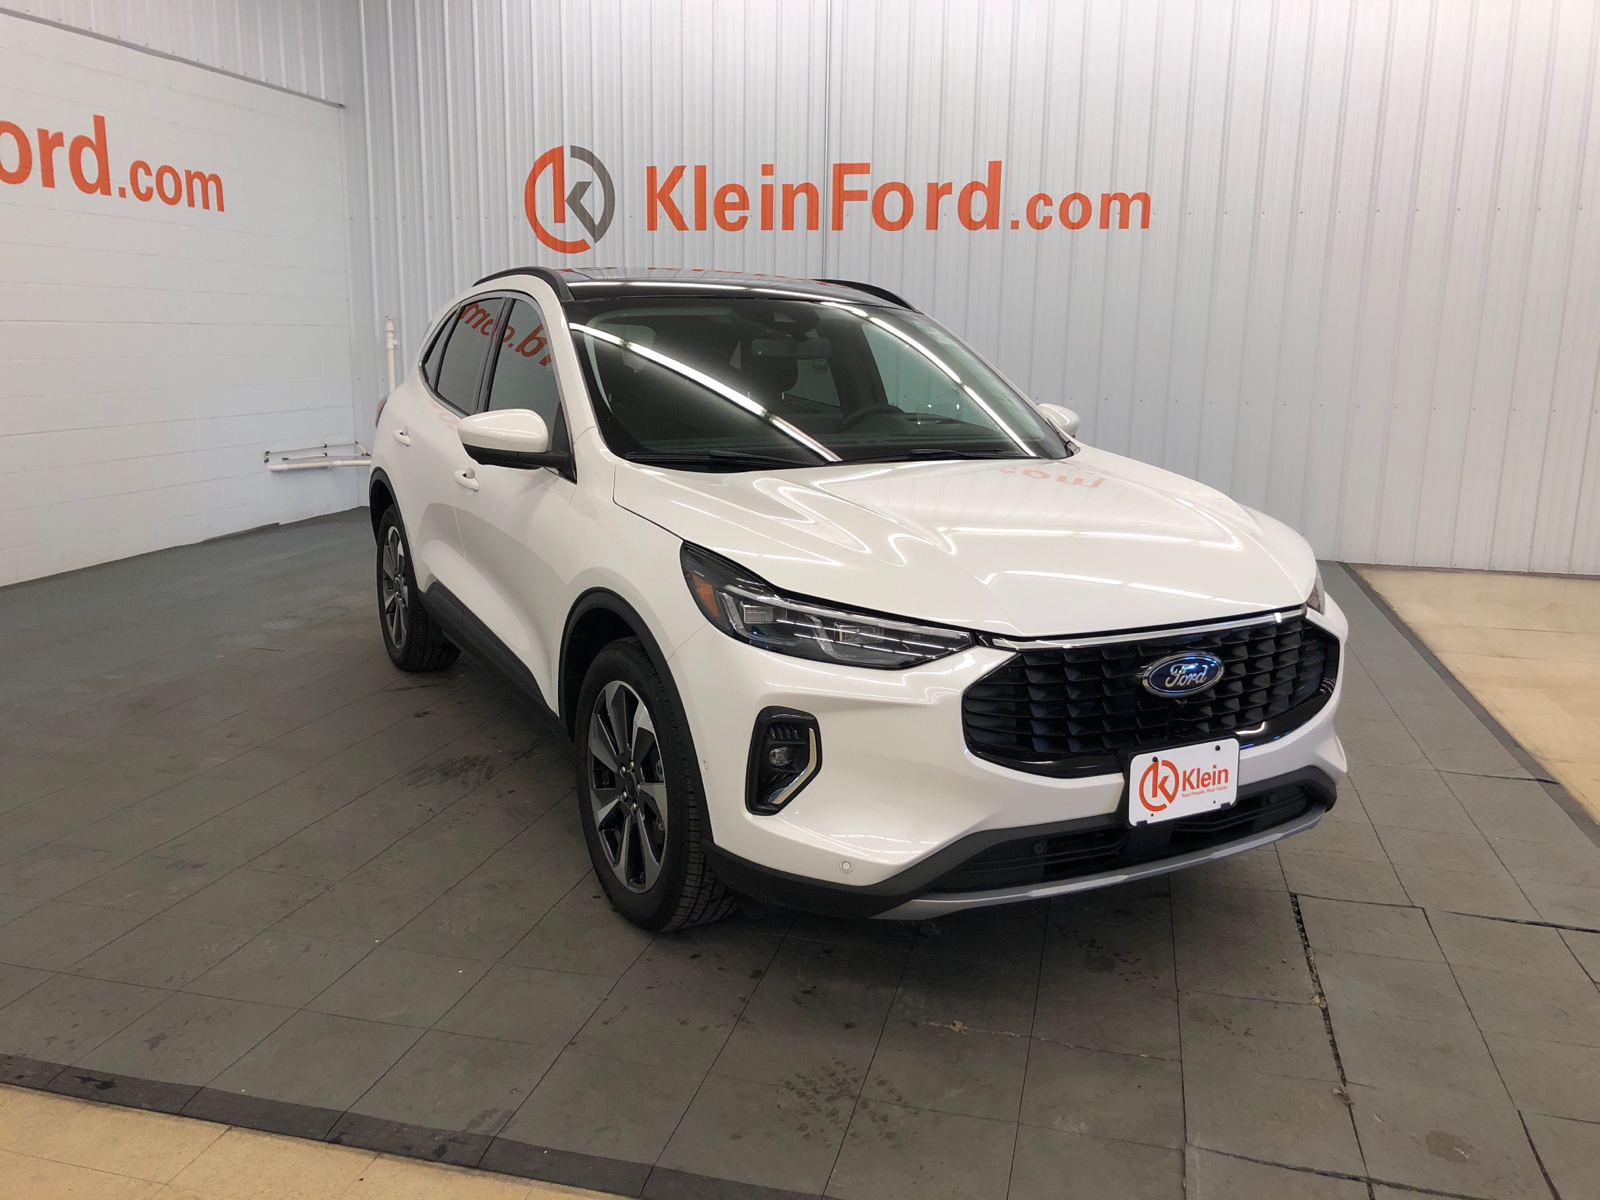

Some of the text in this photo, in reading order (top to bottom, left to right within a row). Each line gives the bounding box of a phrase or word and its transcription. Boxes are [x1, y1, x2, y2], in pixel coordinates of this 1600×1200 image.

[0, 114, 225, 212] ord.com
[646, 160, 1151, 231] KleinFord.com
[1165, 663, 1208, 688] Ford
[1182, 765, 1229, 792] Klein
